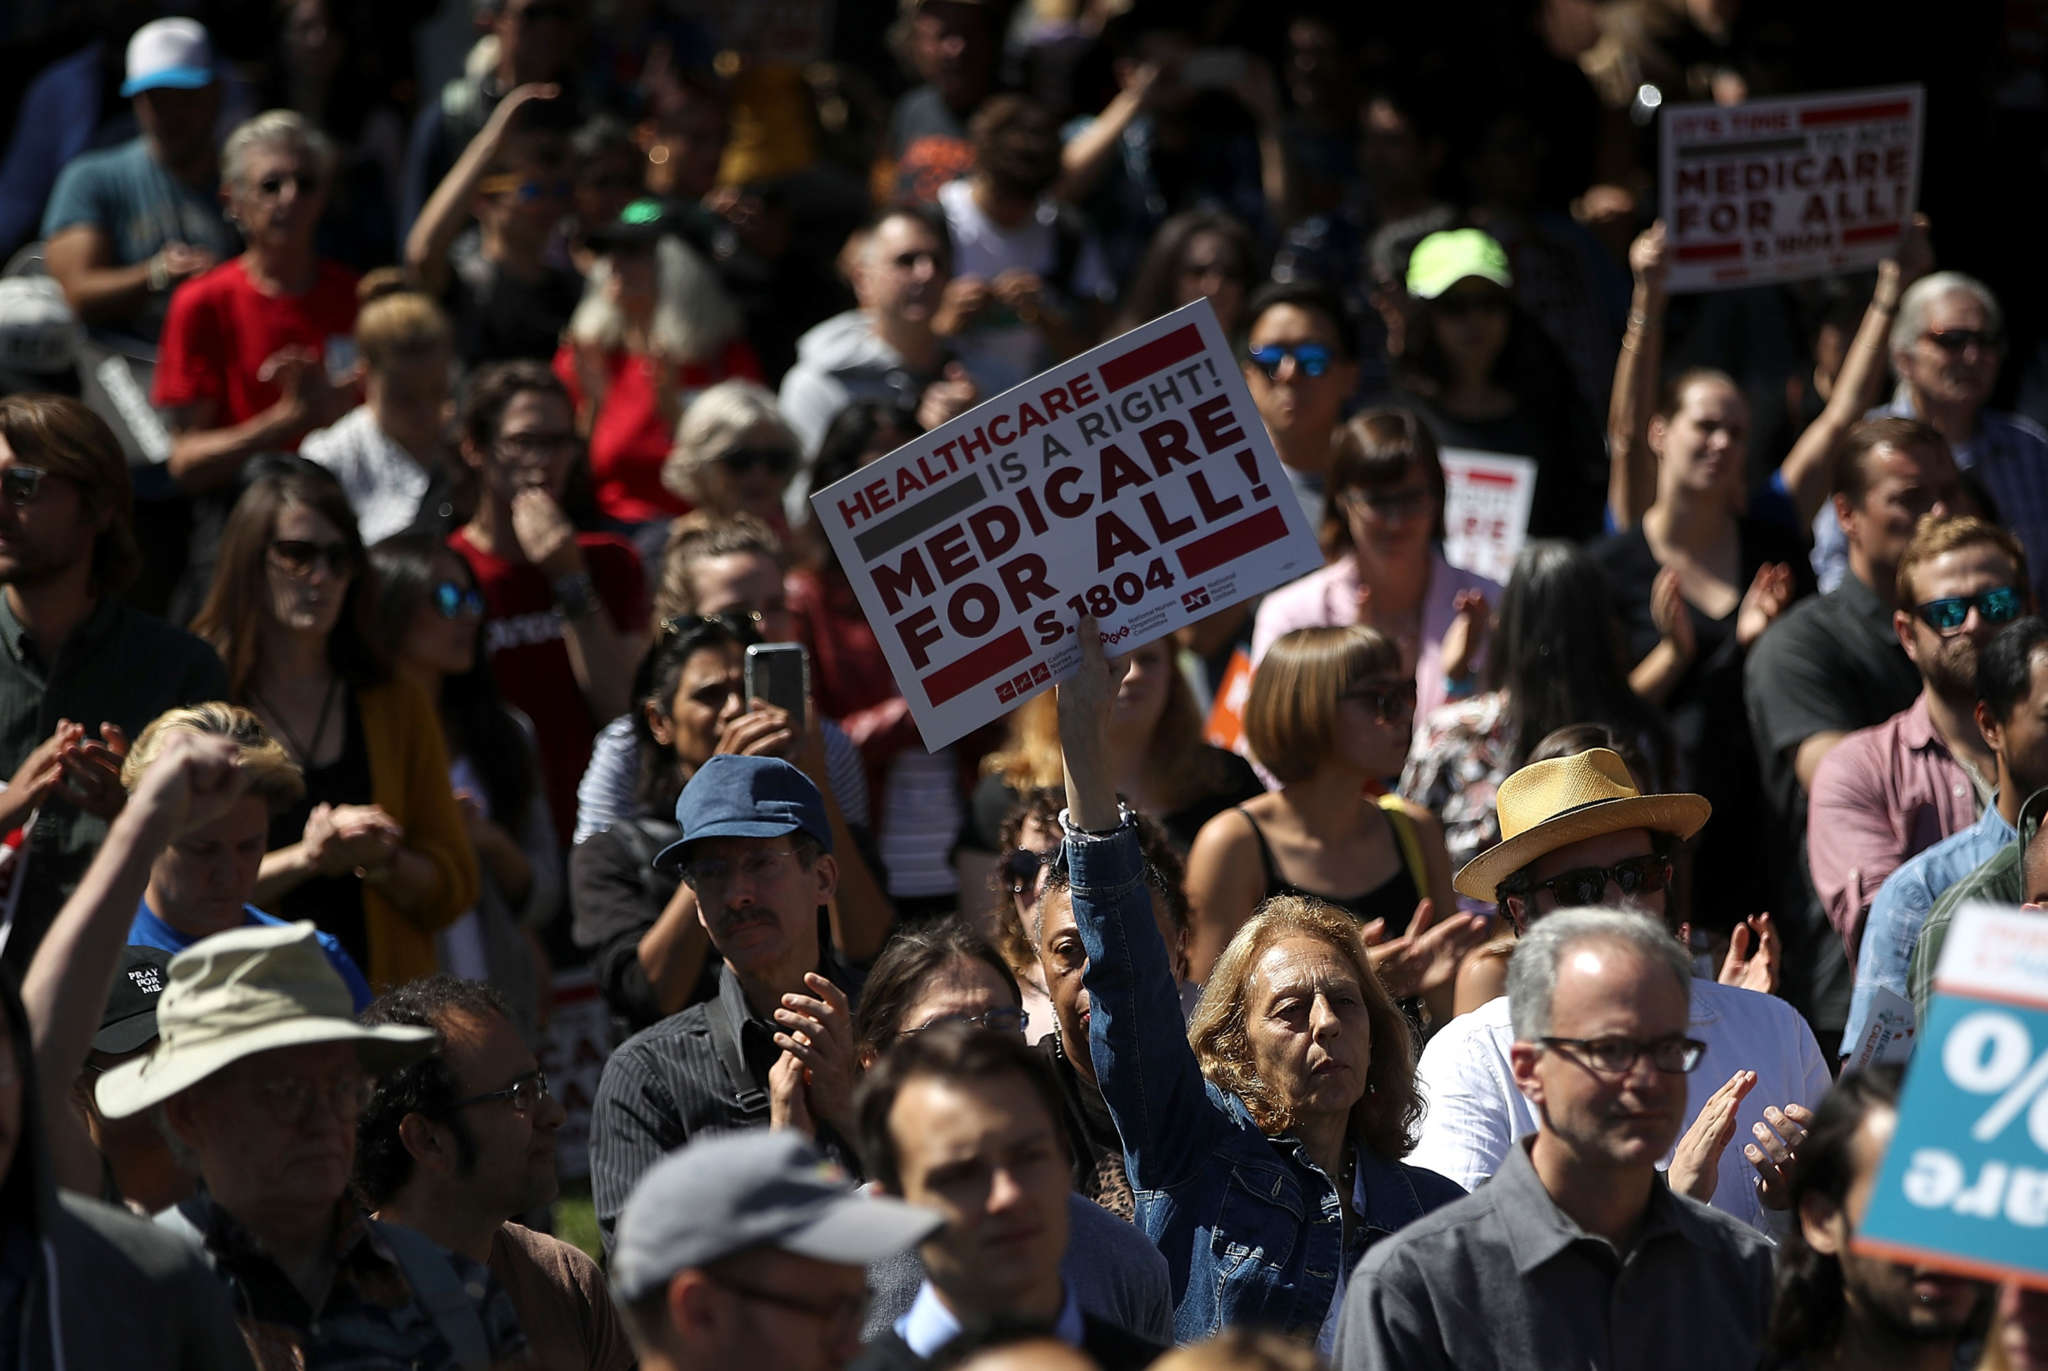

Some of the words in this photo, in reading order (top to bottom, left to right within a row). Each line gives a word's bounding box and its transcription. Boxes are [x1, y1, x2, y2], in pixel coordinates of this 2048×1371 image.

[1676, 147, 1906, 195] MEDICARE
[1676, 200, 1773, 235] FOR
[1803, 186, 1906, 227] ALL!
[837, 372, 1100, 529] HEALTHCARE
[986, 452, 1028, 491] IS
[1041, 434, 1072, 467] A
[1077, 357, 1223, 447] RIGHT!
[869, 393, 1246, 616] MEDICARE
[895, 552, 1060, 671] FOR
[1095, 448, 1272, 573] ALL!
[128, 968, 158, 980] PRAY
[136, 977, 160, 987] FOR
